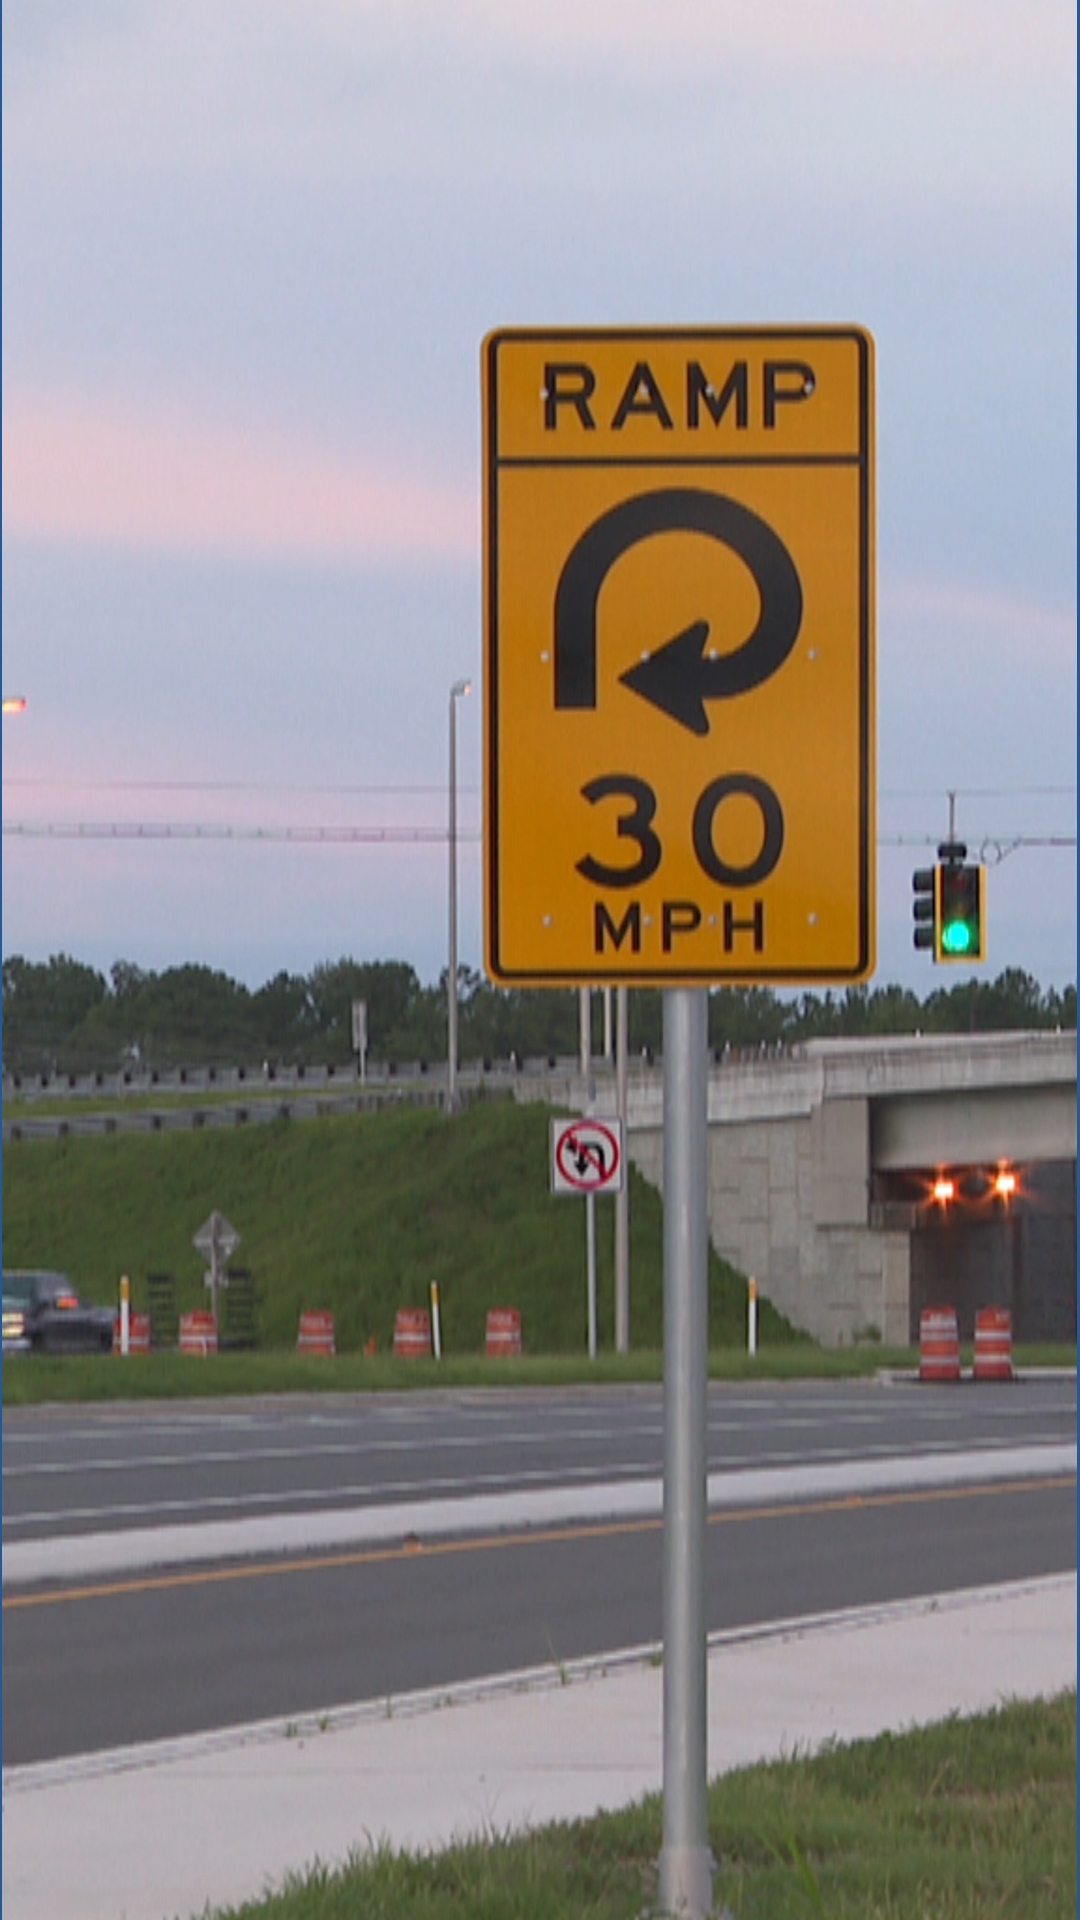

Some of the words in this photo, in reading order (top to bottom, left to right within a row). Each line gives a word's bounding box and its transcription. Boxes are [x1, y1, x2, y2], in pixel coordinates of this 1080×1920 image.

[542, 359, 817, 432] RAMP
[573, 771, 786, 891] 30
[593, 899, 765, 955] MPH
